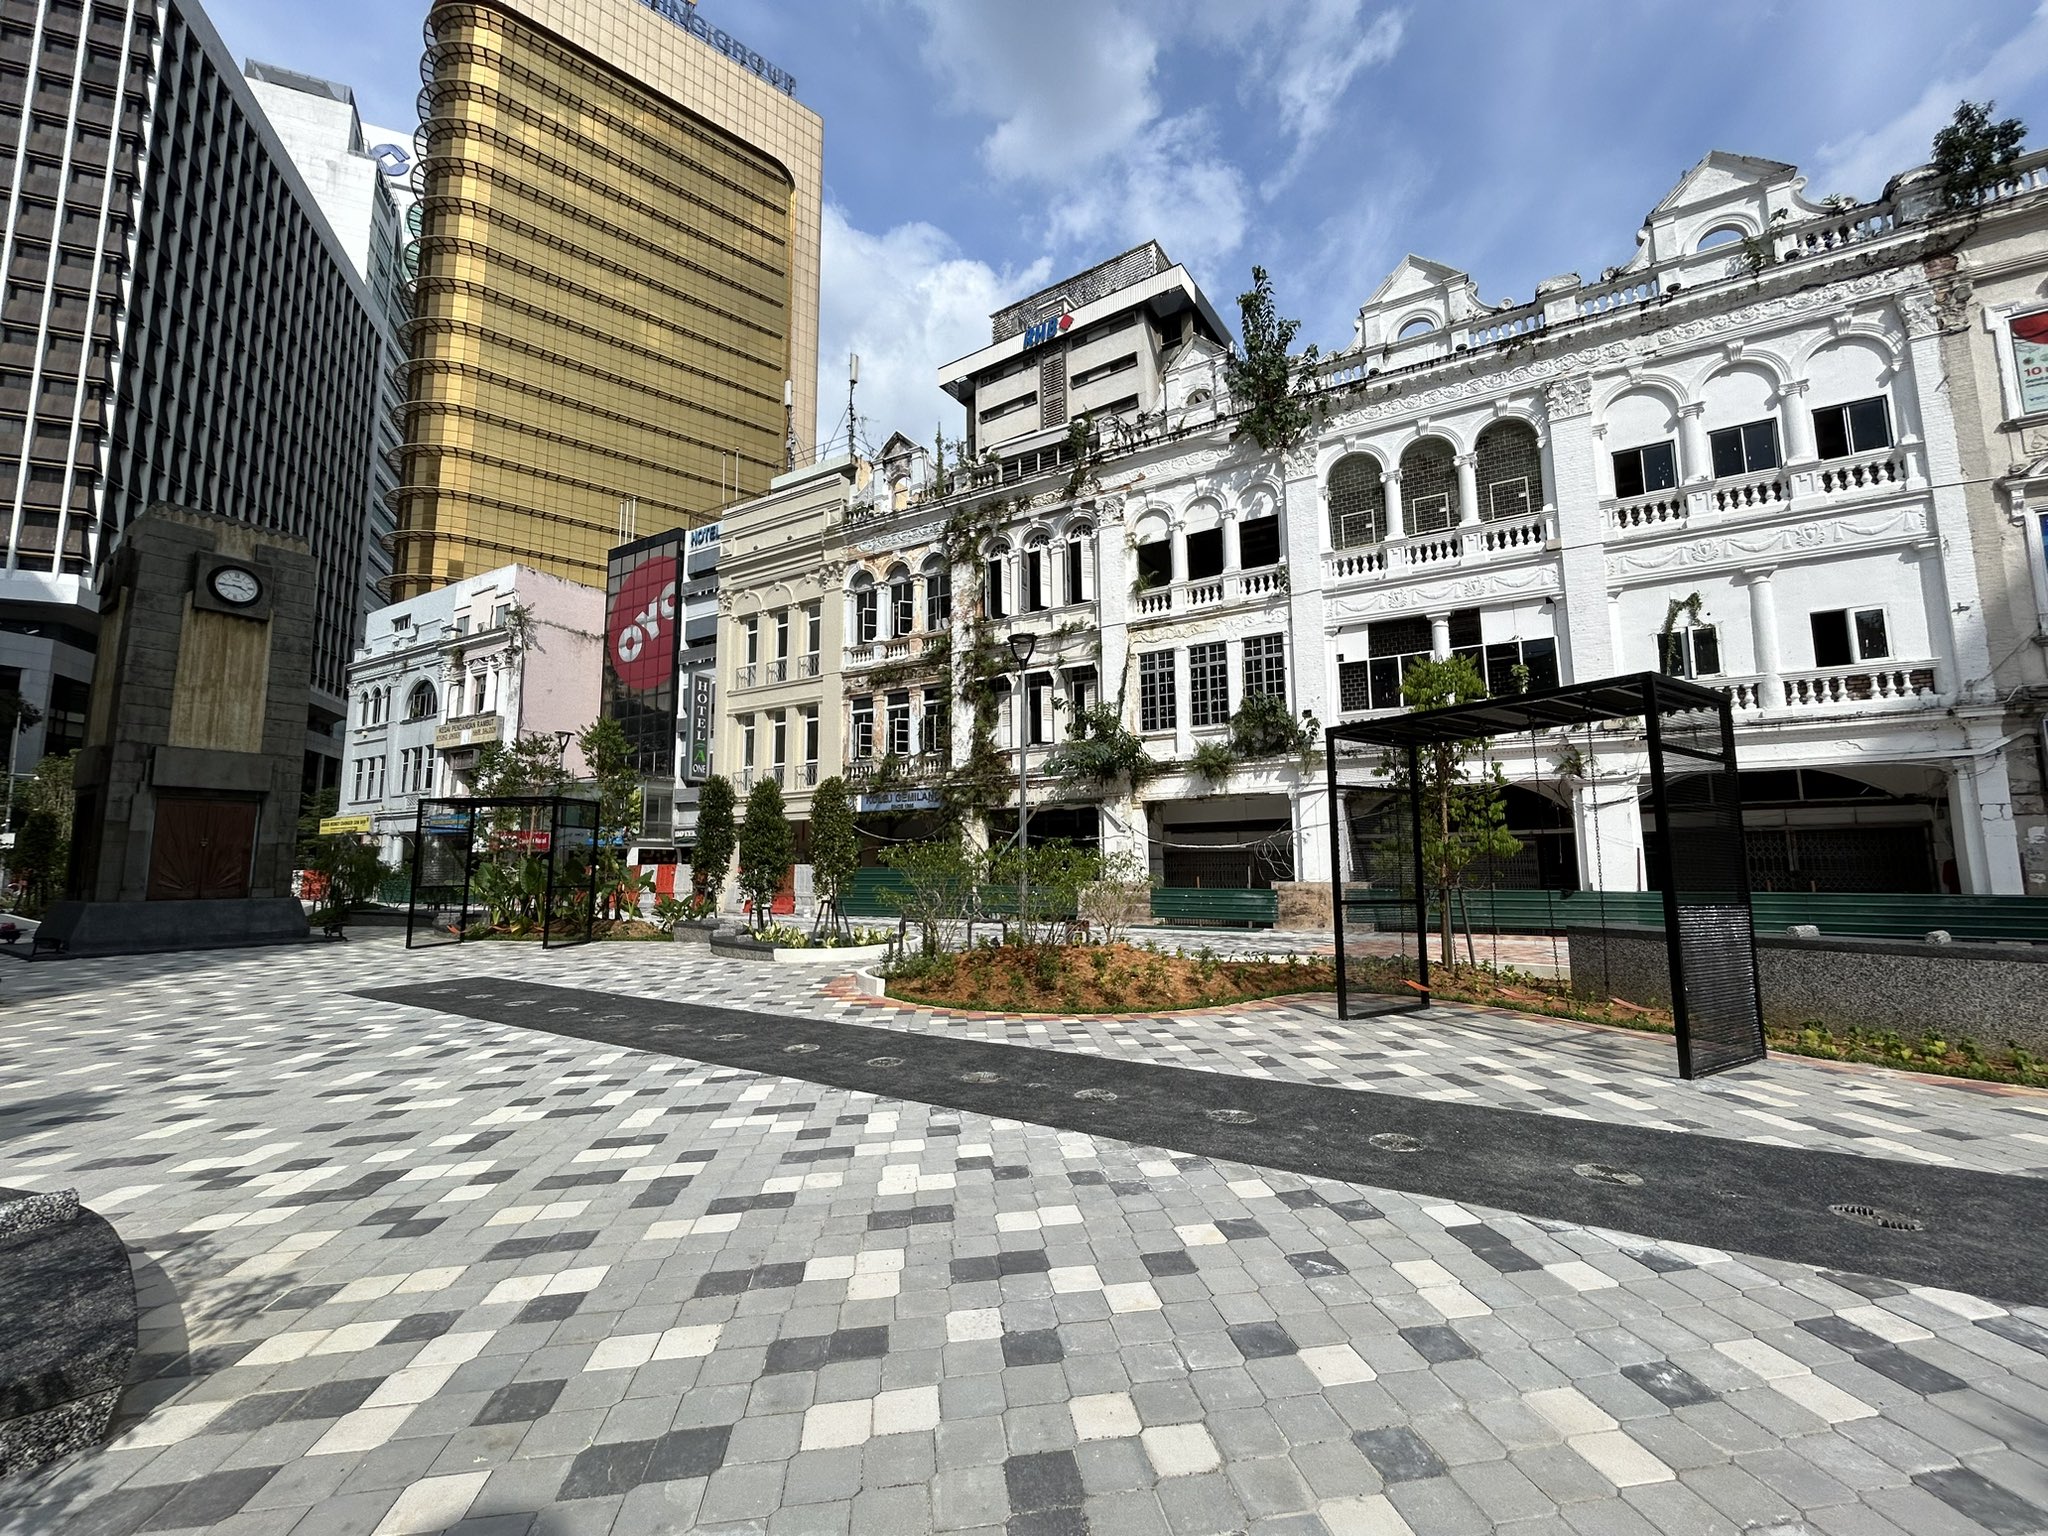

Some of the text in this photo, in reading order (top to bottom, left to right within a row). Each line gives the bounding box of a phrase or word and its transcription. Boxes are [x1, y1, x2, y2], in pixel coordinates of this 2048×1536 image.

[713, 28, 797, 93] GROUP
[1023, 315, 1059, 350] RHB
[690, 524, 720, 548] HOTEL
[618, 580, 676, 662] OYO
[697, 681, 708, 741] HOTEL
[692, 763, 706, 774] ONE
